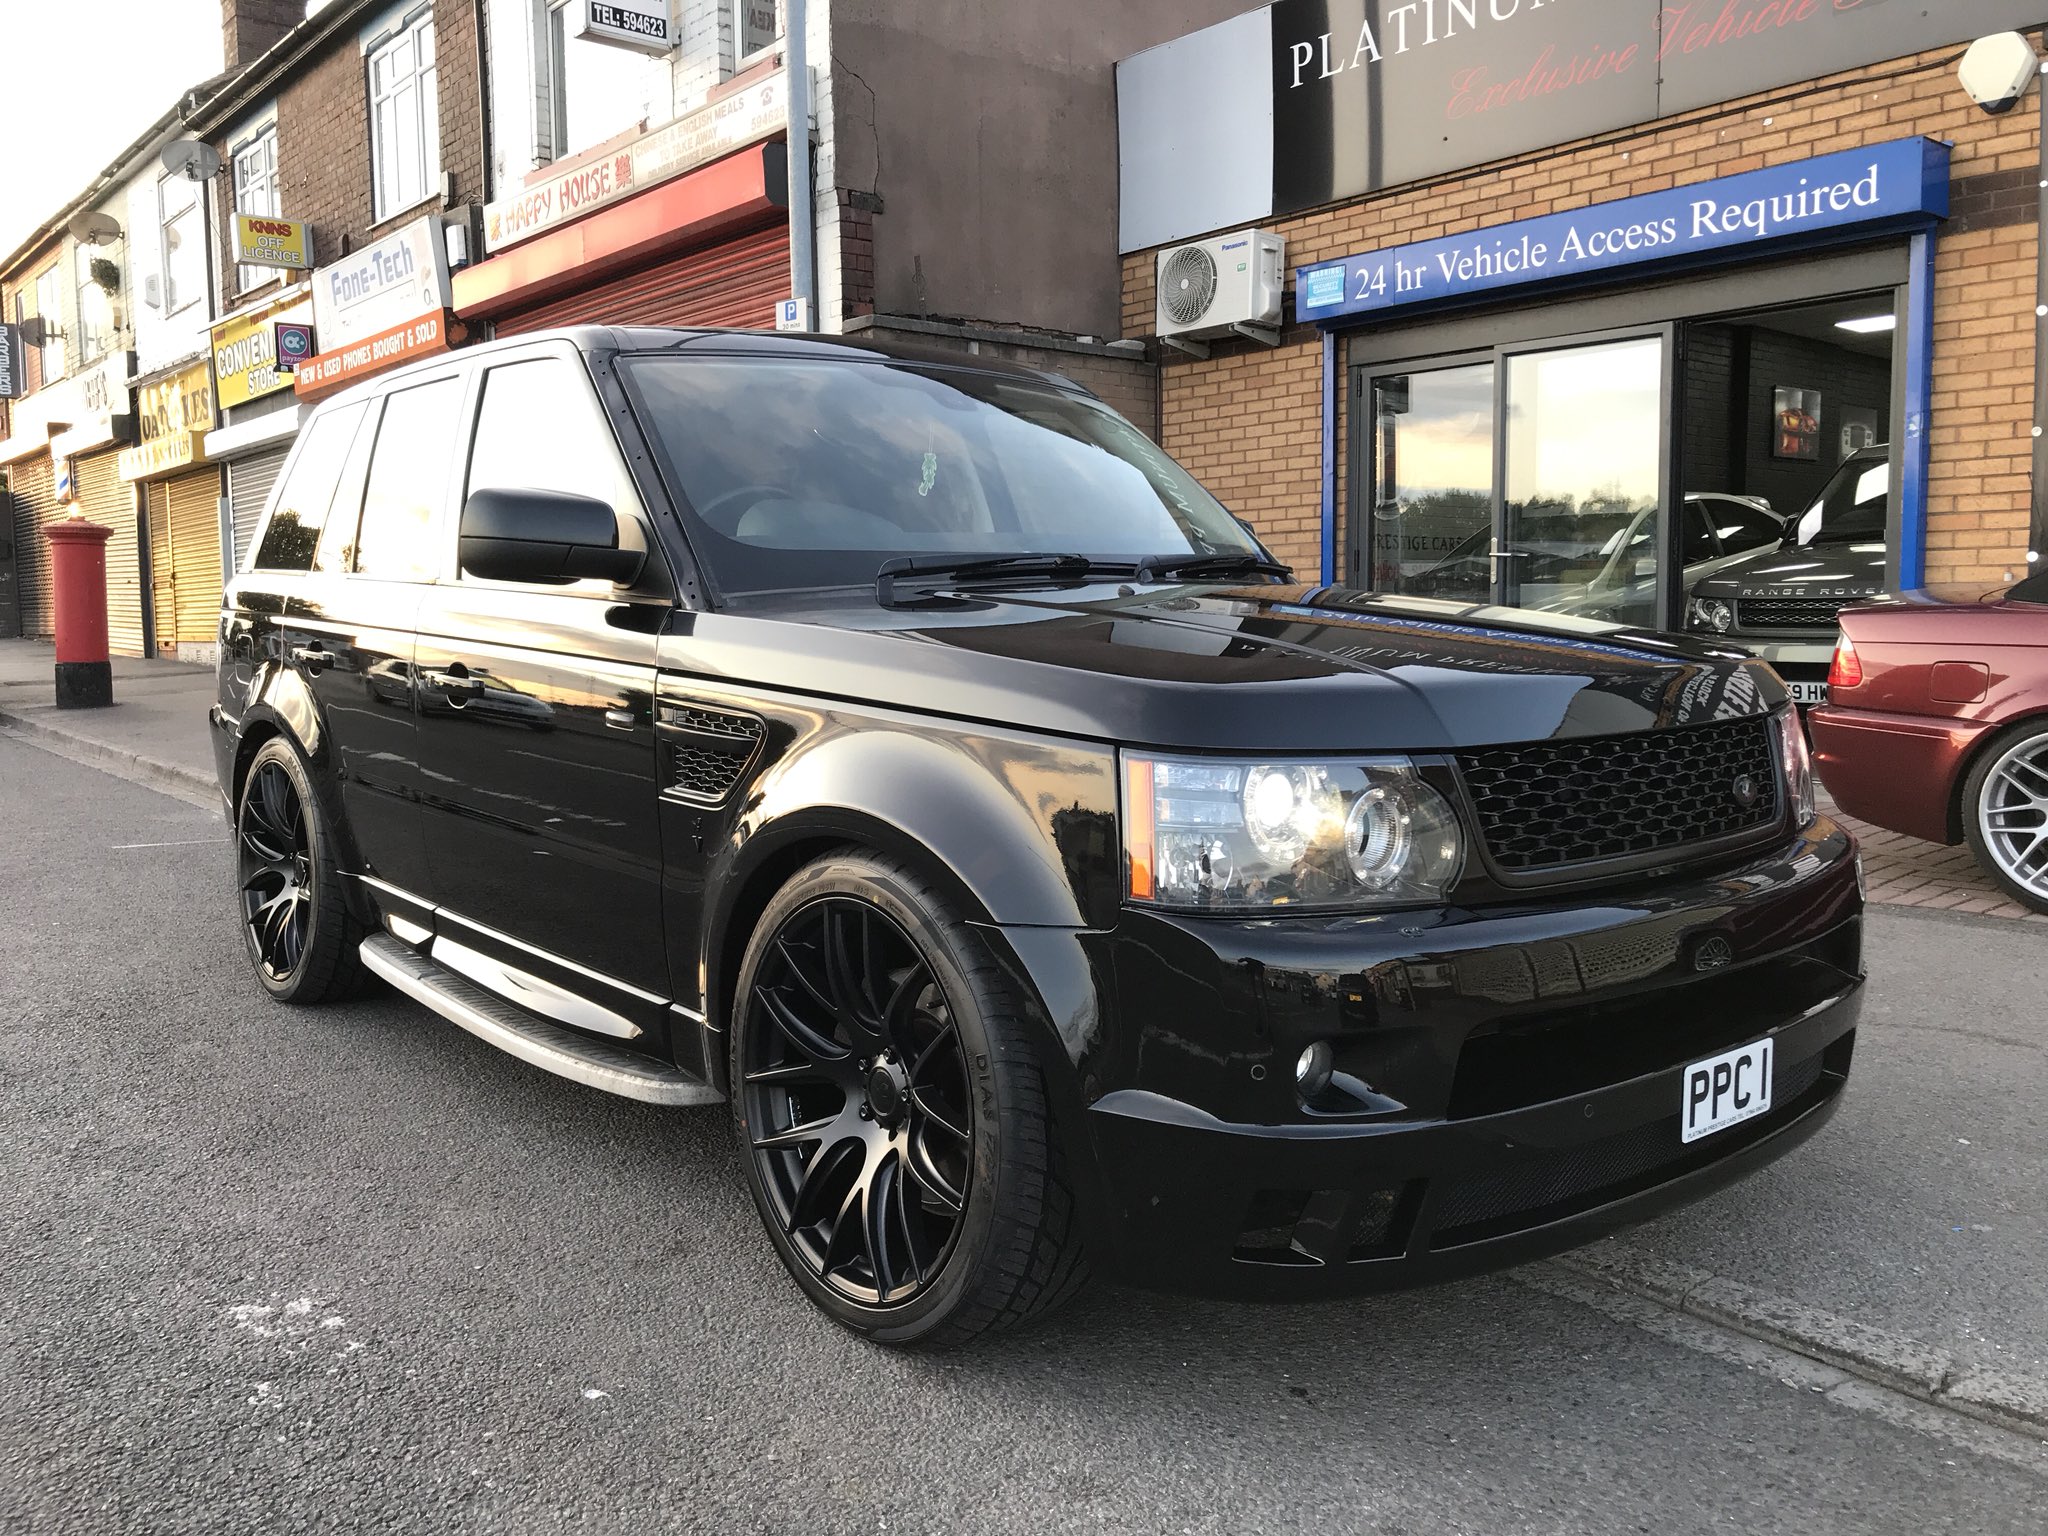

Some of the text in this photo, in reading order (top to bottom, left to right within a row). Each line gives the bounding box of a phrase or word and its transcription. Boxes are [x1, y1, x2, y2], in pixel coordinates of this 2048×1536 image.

[593, 4, 664, 37] TEL: 594623
[1289, 0, 1555, 89] PLATINU
[1446, 42, 1639, 120] Exclusive
[672, 136, 693, 156] TAKE
[695, 125, 718, 145] AWAY
[678, 112, 713, 138] ENGLISH
[715, 97, 745, 121] MEALS
[751, 105, 785, 131] 594623
[505, 187, 551, 235] HAPPY
[559, 162, 611, 213] HOUSE
[243, 245, 301, 263] LICENCE
[257, 235, 285, 249] OFF
[1221, 240, 1248, 252] Panasonic
[1354, 163, 1880, 300] 24 hr Vehicle Access Required
[330, 240, 415, 306] Fone-Tech
[217, 331, 277, 380] CONVENI
[300, 365, 317, 385] NEW
[317, 364, 323, 380] &
[324, 355, 341, 378] USED
[343, 345, 372, 371] PHONES
[373, 331, 405, 357] BOUGHT
[407, 328, 414, 347] &
[415, 319, 437, 344] SOLD
[248, 363, 282, 395] STORE
[142, 387, 209, 441] OATCKES
[1742, 588, 1806, 596] RANGE
[976, 1053, 993, 1121] DIAS
[1689, 1054, 1752, 1129] PPC
